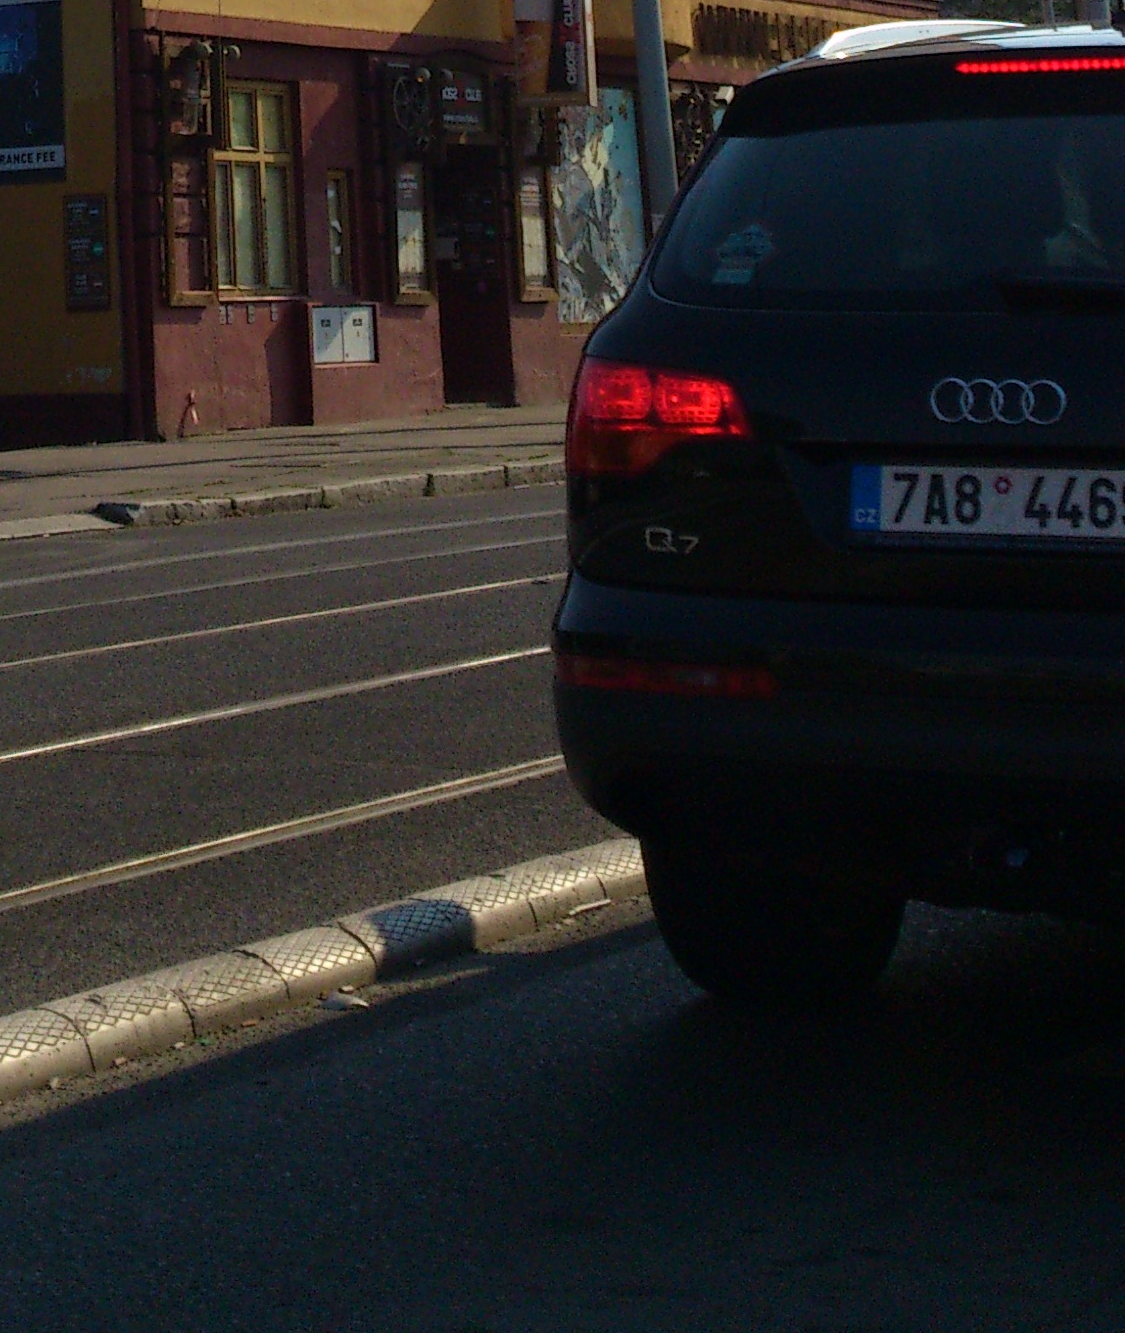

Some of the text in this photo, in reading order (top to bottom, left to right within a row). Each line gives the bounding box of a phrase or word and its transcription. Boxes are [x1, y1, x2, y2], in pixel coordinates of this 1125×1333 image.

[36, 150, 56, 163] FEE
[892, 473, 1125, 530] 7A8 446
[855, 508, 877, 523] CZ
[644, 525, 700, 556] Q7
